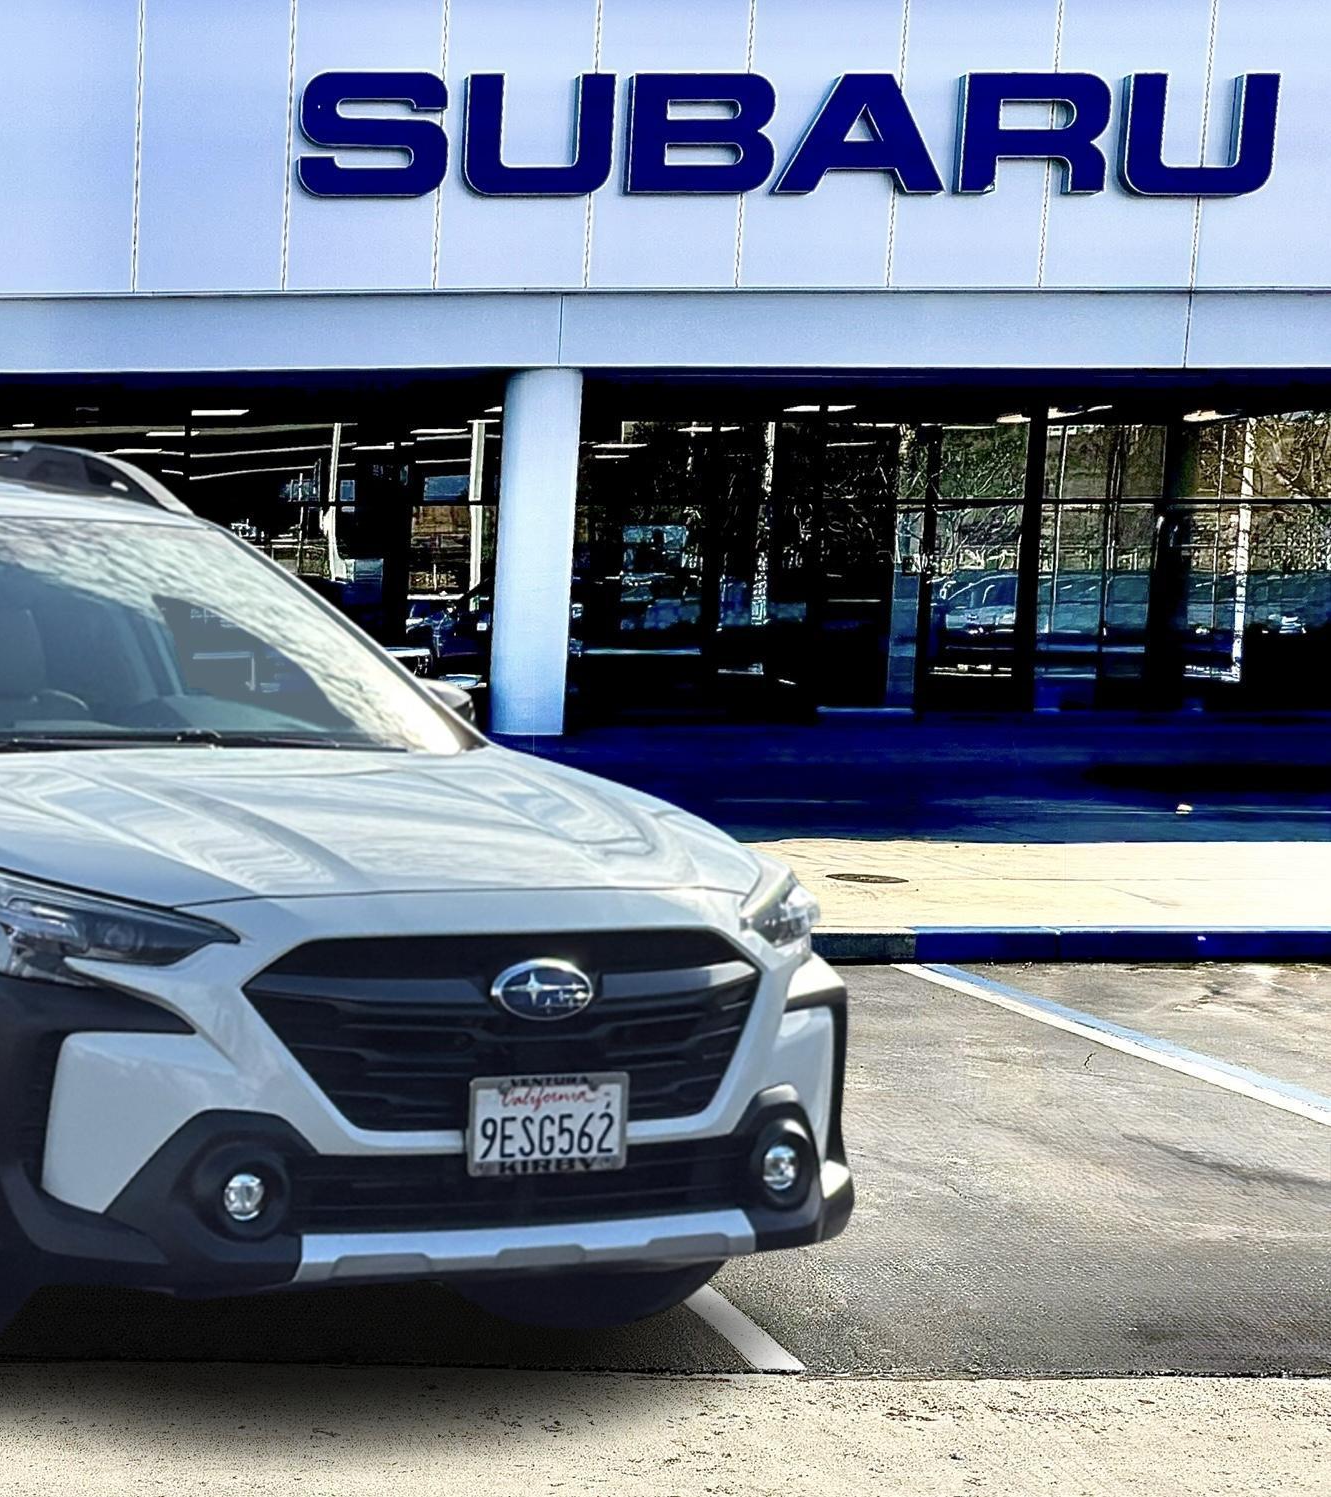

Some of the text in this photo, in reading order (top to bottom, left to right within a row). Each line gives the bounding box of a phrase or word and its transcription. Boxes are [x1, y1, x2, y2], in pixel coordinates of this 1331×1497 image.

[297, 71, 1281, 198] SUBARU
[510, 1075, 589, 1087] VENTURA
[501, 1086, 598, 1112] California
[479, 1111, 614, 1160] 9ESG562
[499, 1157, 596, 1174] KIRBY
